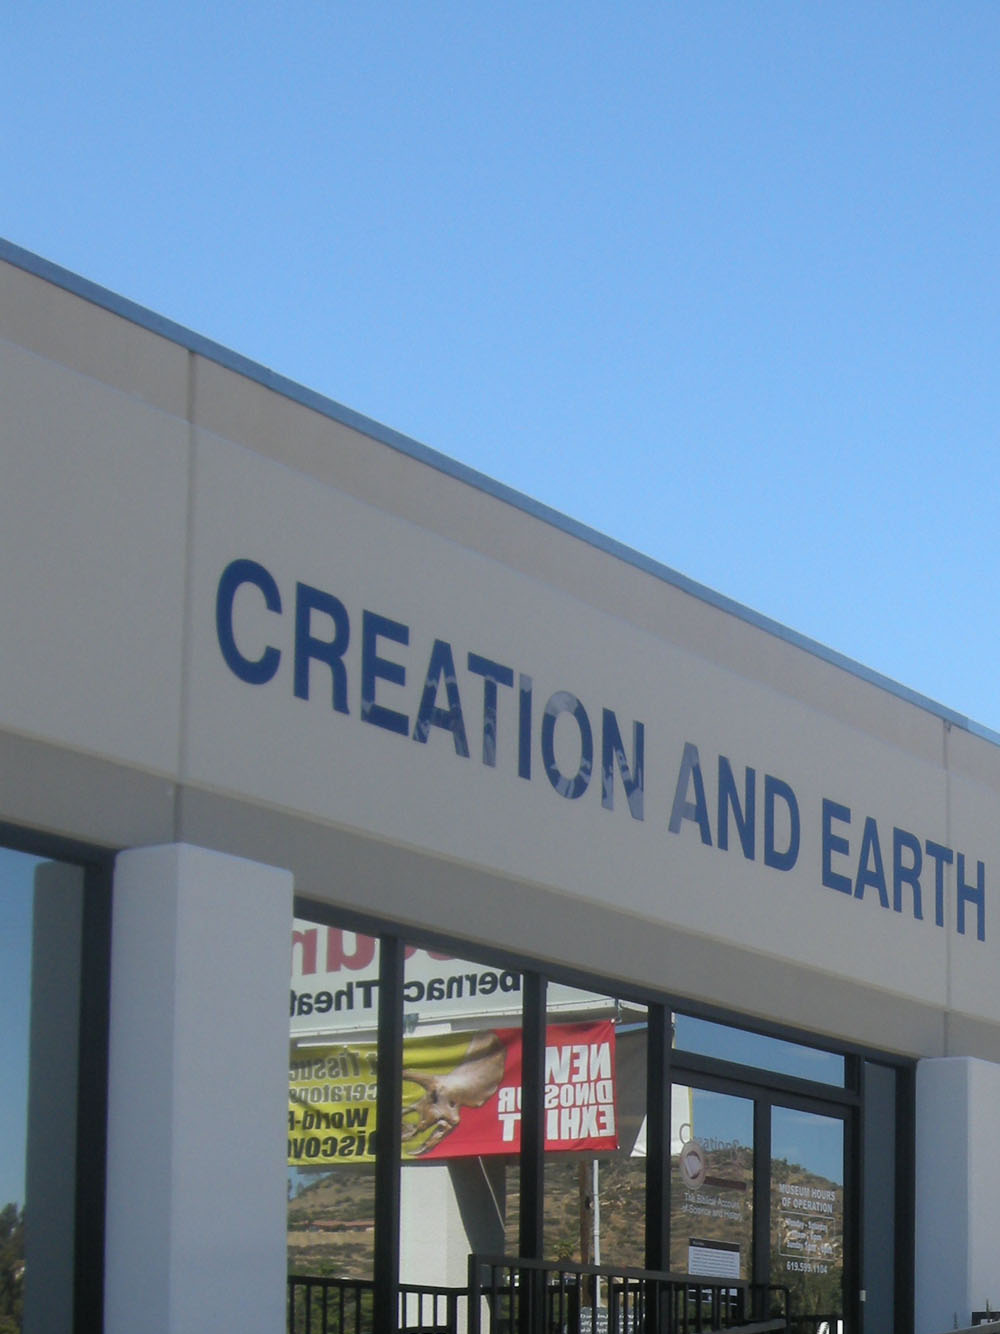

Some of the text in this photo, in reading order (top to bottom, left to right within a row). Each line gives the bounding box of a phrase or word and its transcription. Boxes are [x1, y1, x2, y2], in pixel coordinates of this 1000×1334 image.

[215, 557, 645, 822] CREATION
[667, 741, 801, 872] AND
[821, 797, 986, 942] EARTH
[779, 1183, 836, 1201] MUSEUM HOURS
[781, 1197, 833, 1213] OF OPERATION
